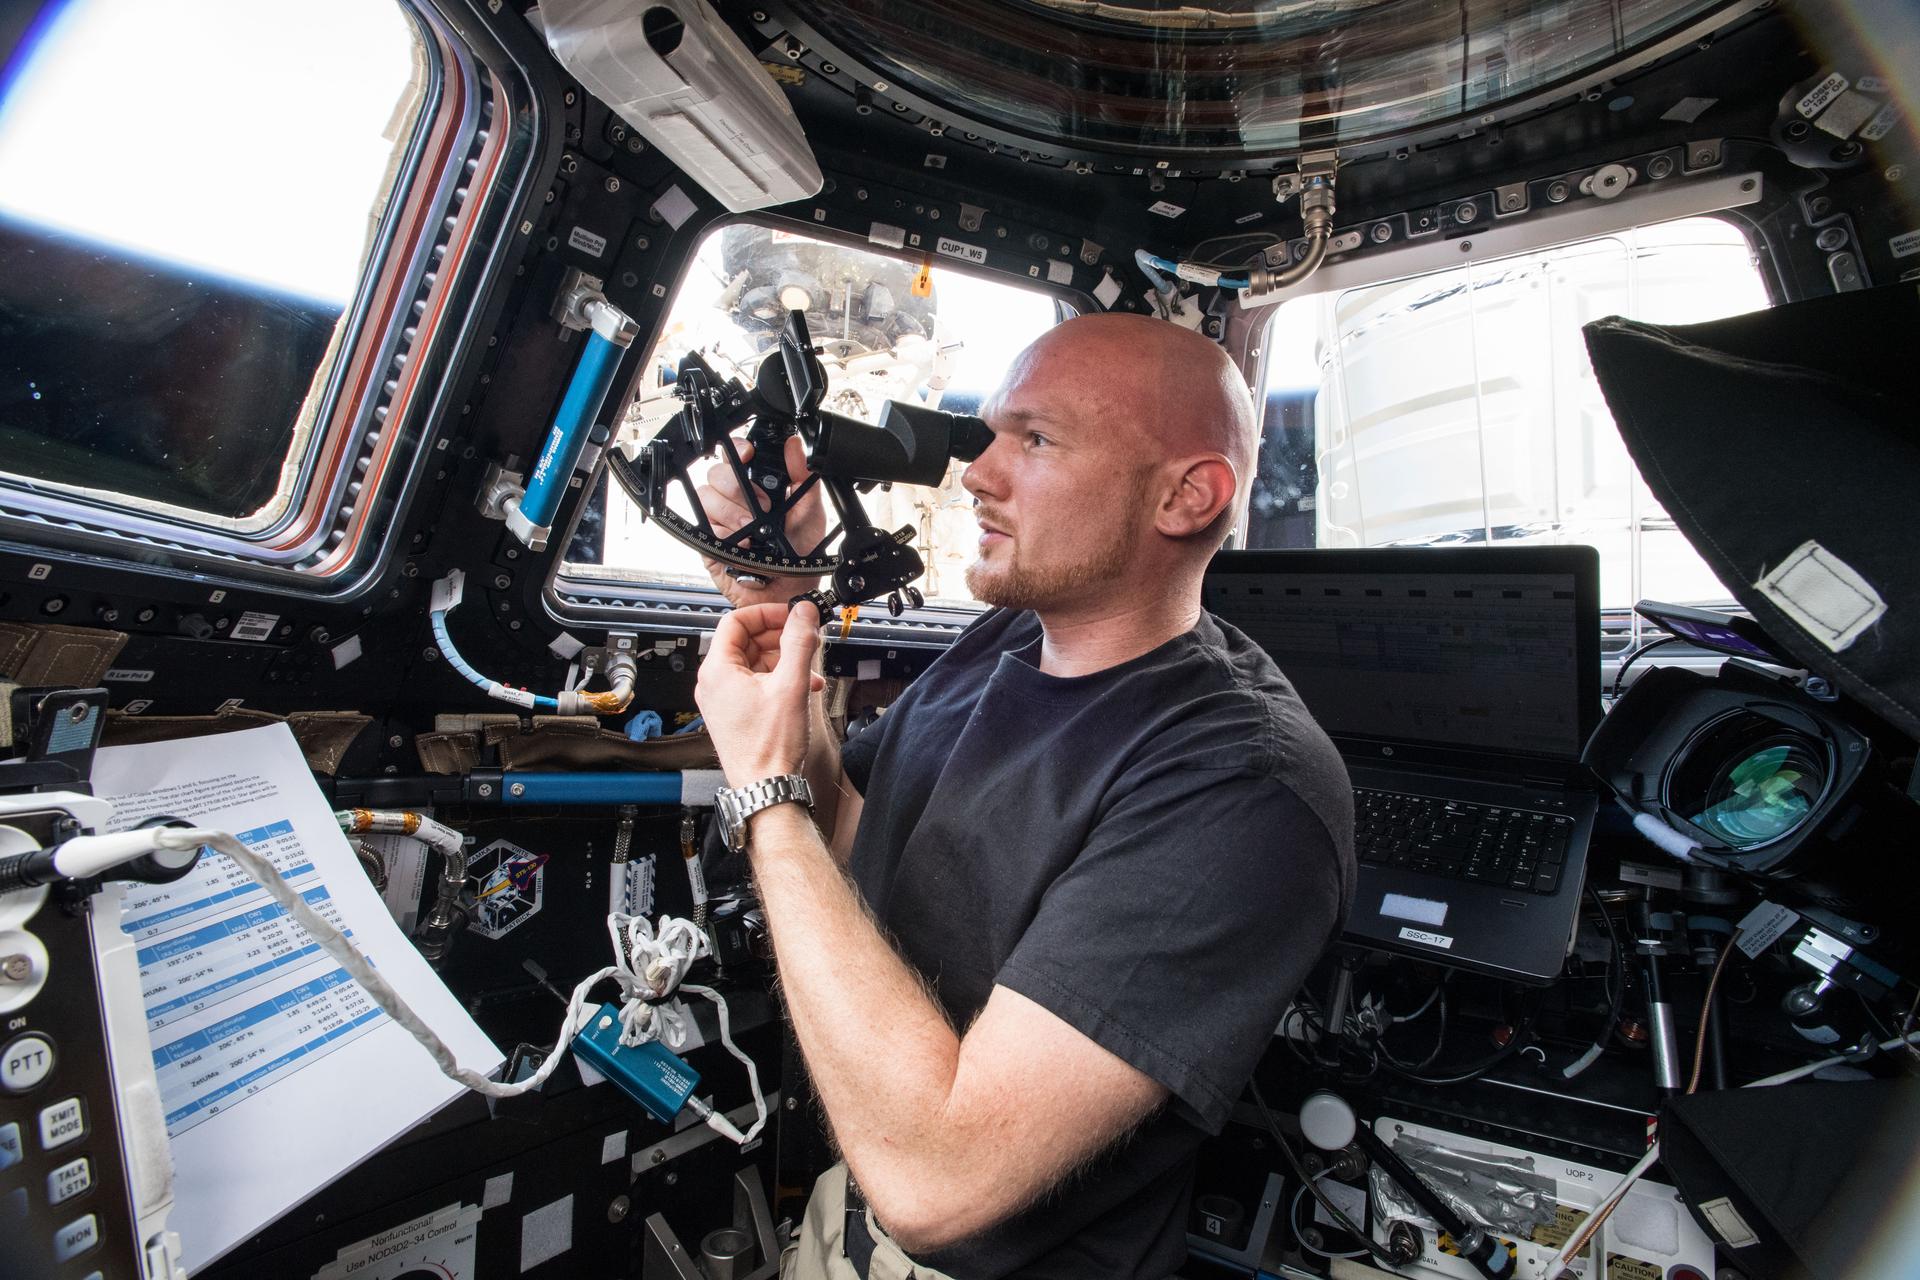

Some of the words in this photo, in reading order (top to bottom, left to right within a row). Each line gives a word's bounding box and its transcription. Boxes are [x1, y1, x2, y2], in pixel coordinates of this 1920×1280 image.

[1802, 78, 1836, 108] CLOSED
[940, 241, 983, 260] CUP1_W5
[667, 511, 678, 521] 120
[682, 520, 692, 530] 110
[33, 567, 46, 576] B
[213, 591, 222, 601] 5
[108, 671, 116, 679] R
[115, 671, 129, 679] Lwr
[129, 672, 143, 680] Pnl
[126, 701, 145, 714] G
[504, 911, 532, 932] PATRICK
[1406, 930, 1445, 945] SSC-17
[143, 985, 168, 999] etUMa
[154, 1018, 165, 1028] 21
[193, 1002, 205, 1011] 0.7
[8, 1016, 28, 1031] ON
[10, 1050, 45, 1076] PTT
[179, 1054, 203, 1070] Alkaid
[190, 1069, 220, 1089] ZetUMa
[51, 1106, 77, 1124] XMIT
[208, 1105, 220, 1116] 40
[51, 1119, 80, 1139] MODE
[58, 1164, 86, 1183] TALK
[1565, 1167, 1586, 1180] UOP
[1587, 1172, 1595, 1182] 2
[60, 1179, 88, 1199] LSTN
[1208, 1219, 1217, 1233] 4
[66, 1226, 92, 1249] MON
[454, 1233, 473, 1246] Warm
[346, 1259, 367, 1274] Use
[368, 1233, 426, 1264] NOD3D2-34
[427, 1219, 458, 1240] Control
[1614, 1261, 1656, 1280] CAUTION
